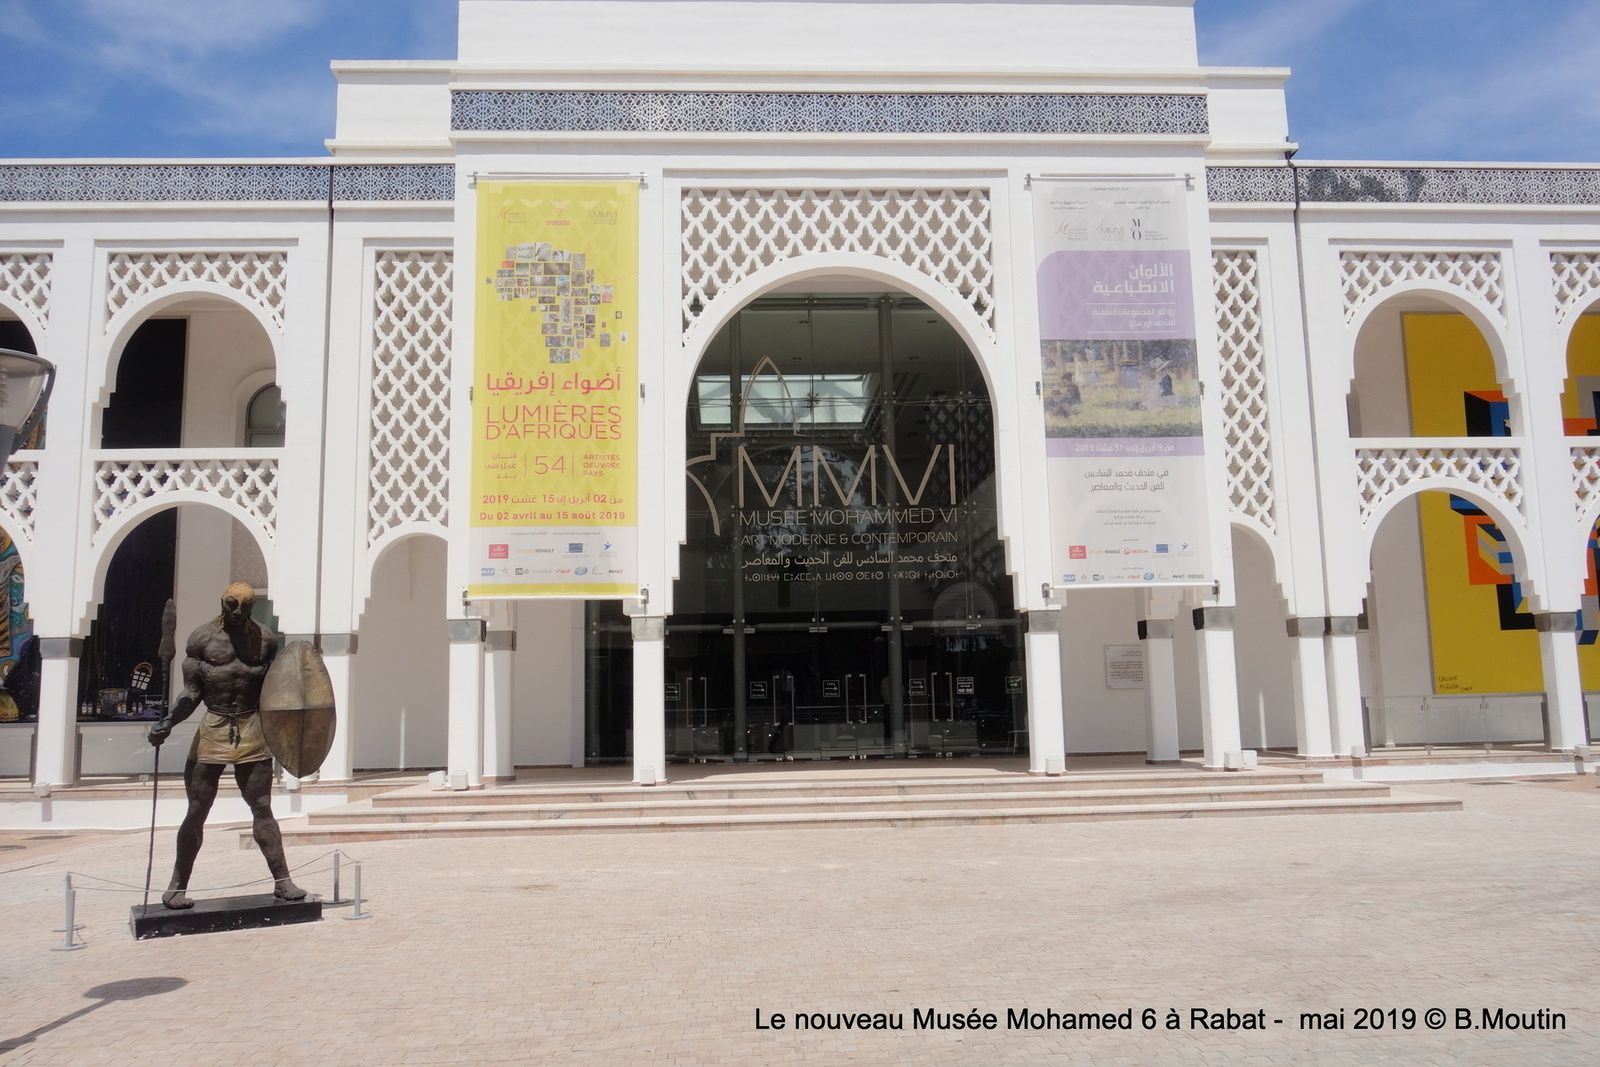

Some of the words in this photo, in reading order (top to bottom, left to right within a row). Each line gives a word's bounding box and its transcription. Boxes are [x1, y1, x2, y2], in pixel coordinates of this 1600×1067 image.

[1128, 262, 1174, 280] الألوان
[1093, 279, 1175, 297] الانطباعية
[486, 370, 556, 397] إفريقيا
[562, 366, 622, 395] أضواء
[486, 400, 622, 424] LUMIÈRES
[533, 454, 567, 476] 54
[582, 470, 605, 478] PAYS
[738, 444, 957, 507] MMVI
[482, 495, 509, 504] 2019
[543, 494, 555, 503] 15
[593, 494, 608, 503] 02
[479, 512, 494, 520] Du
[496, 512, 509, 520] 02
[512, 511, 537, 520] avril
[556, 511, 569, 520] 15
[571, 510, 596, 520] août
[599, 511, 625, 520] 2019
[813, 508, 935, 525] MOHAMMED
[939, 508, 958, 524] VI
[741, 535, 765, 546] ART
[769, 533, 837, 546] MODERNE
[839, 534, 849, 545] &
[851, 532, 958, 545] CONTEMPORAIN
[741, 552, 791, 569] والمعاصر
[795, 552, 829, 567] الحديث
[834, 552, 853, 568] للفن
[856, 551, 894, 567] السادس
[898, 553, 923, 564] محمد
[927, 551, 958, 563] متحف
